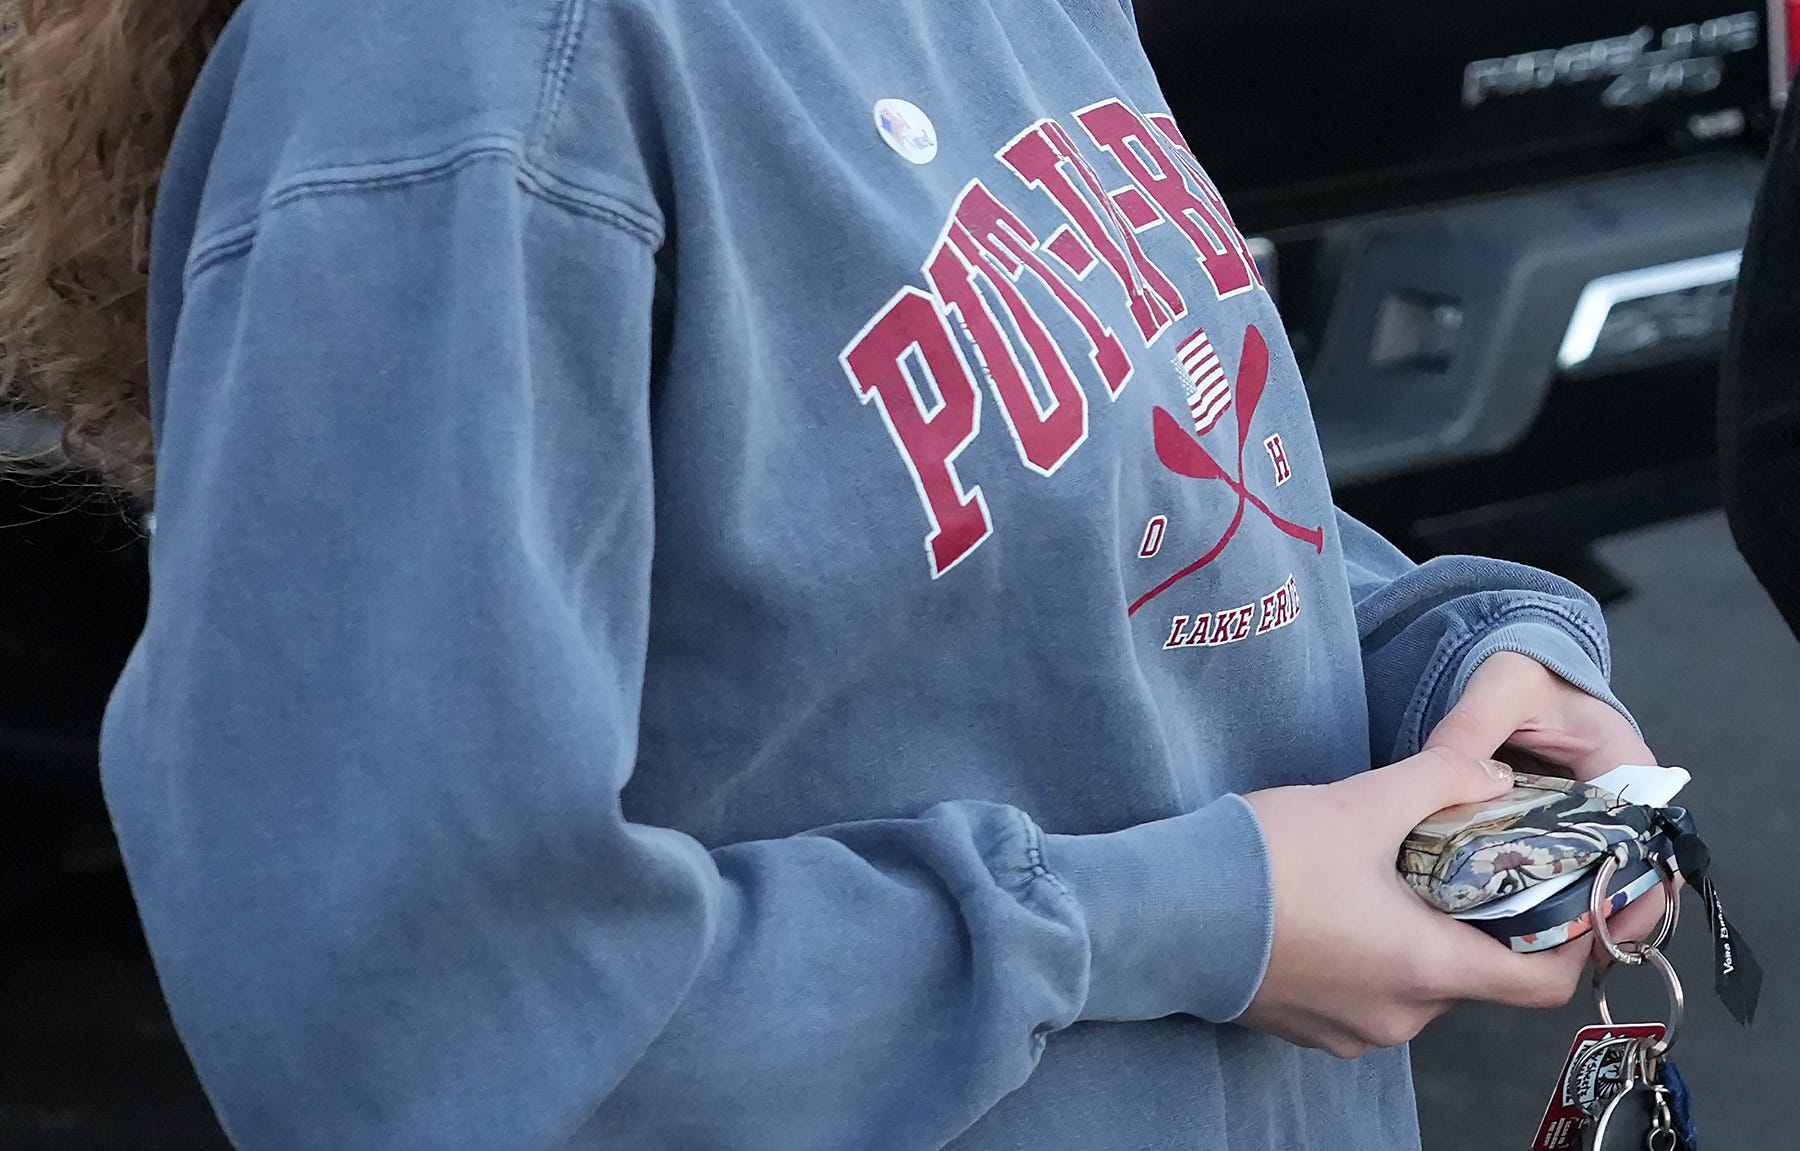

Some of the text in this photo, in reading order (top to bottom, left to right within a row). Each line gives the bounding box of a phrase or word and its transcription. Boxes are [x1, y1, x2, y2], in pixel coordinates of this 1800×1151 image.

[838, 96, 1264, 580] PUT-IN-B
[1263, 432, 1292, 487] H
[1162, 602, 1255, 650] LAKE
